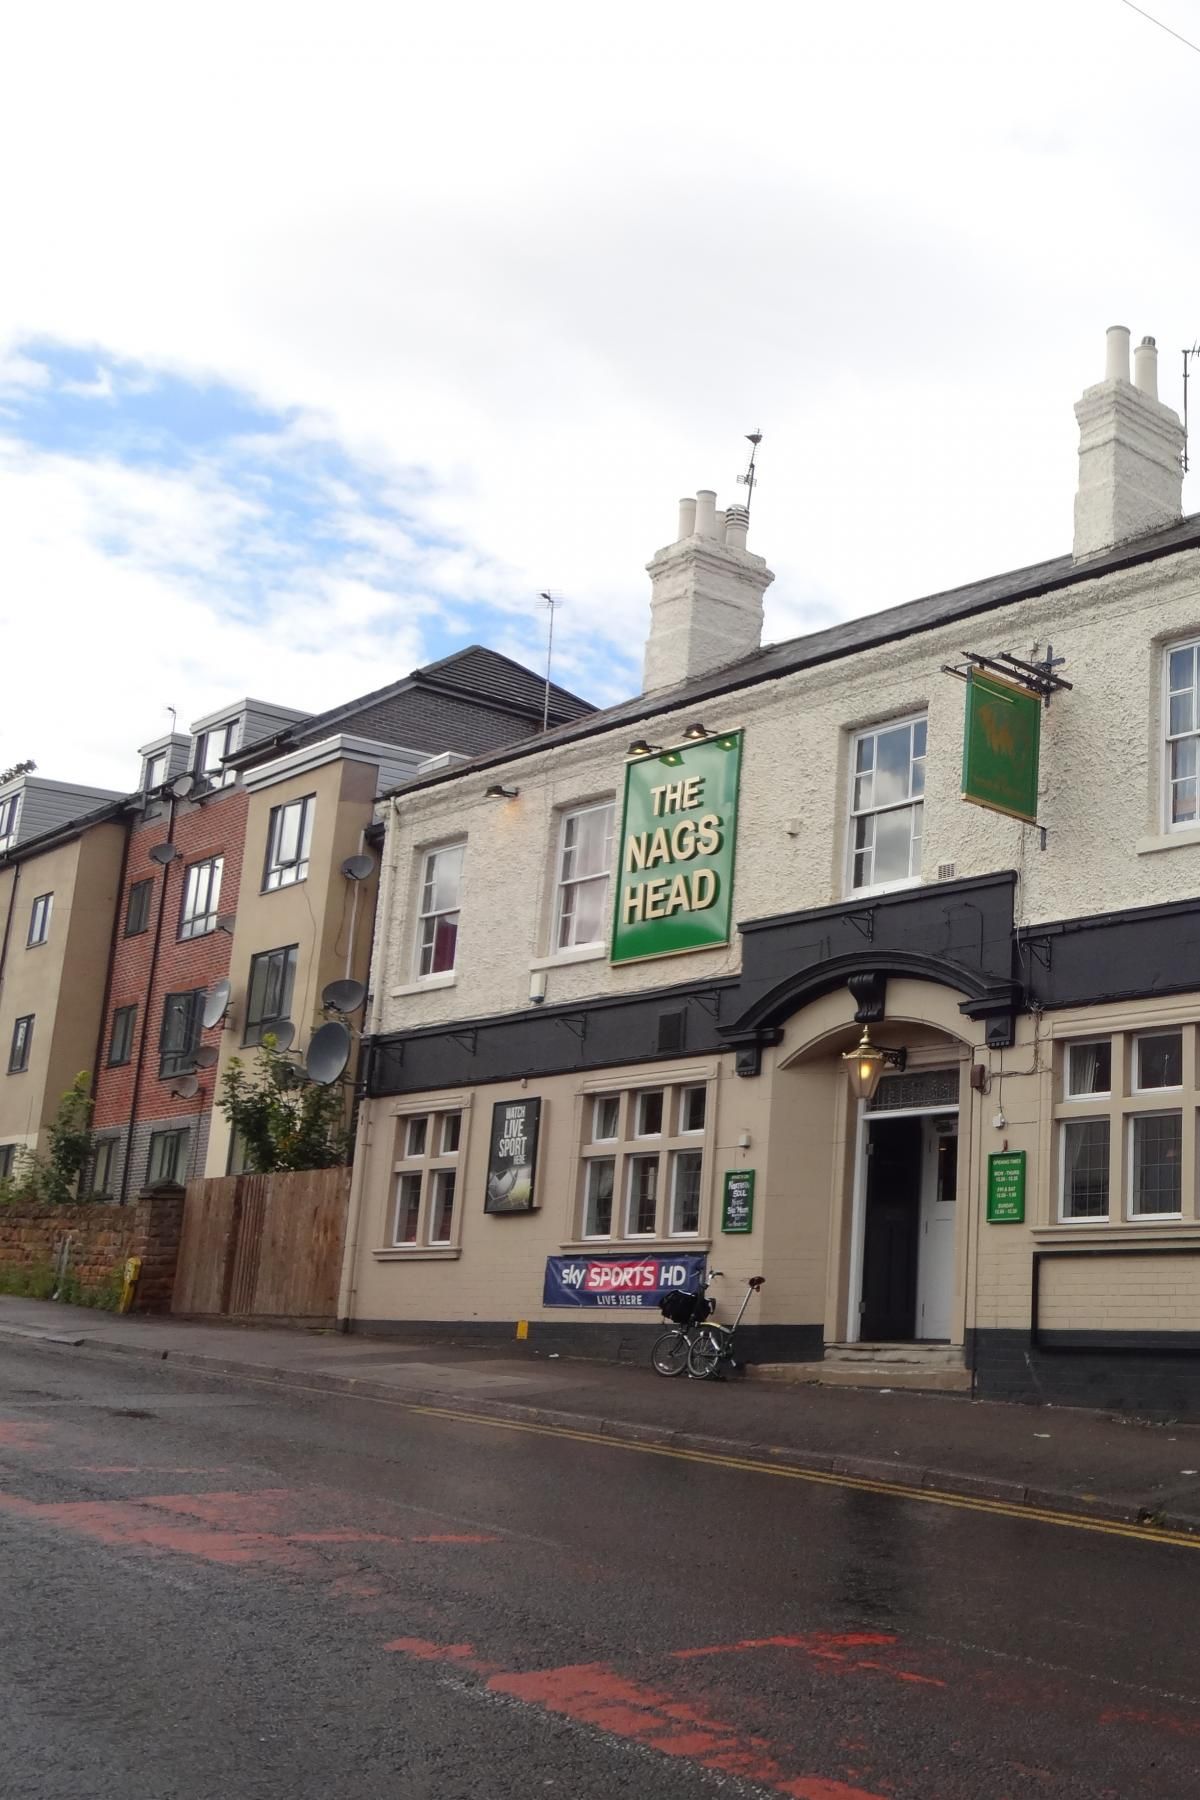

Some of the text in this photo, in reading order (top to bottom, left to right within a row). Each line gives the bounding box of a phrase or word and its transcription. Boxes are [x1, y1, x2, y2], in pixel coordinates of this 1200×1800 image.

[650, 775, 702, 816] THE
[626, 814, 721, 873] NAGS
[623, 868, 717, 924] HEAD
[505, 1105, 526, 1119] WATCH
[503, 1118, 525, 1139] LIVE
[498, 1137, 527, 1158] SPORT
[513, 1154, 526, 1165] HERE
[562, 1264, 687, 1289] sky SPORTS HD
[597, 1295, 642, 1305] LIVE HERE
